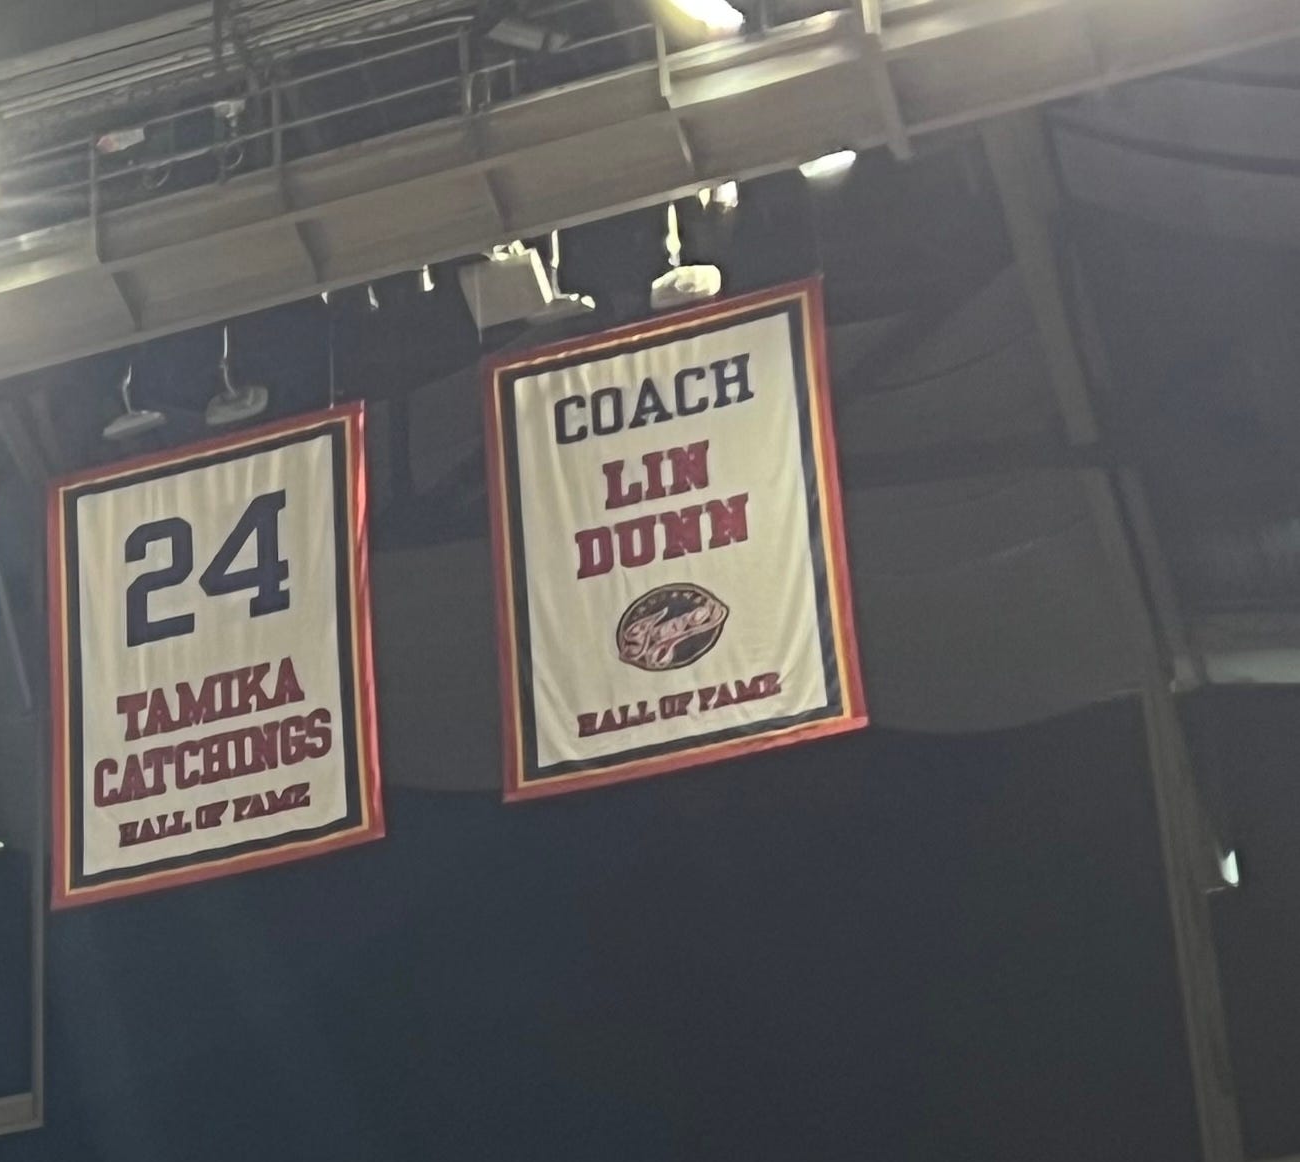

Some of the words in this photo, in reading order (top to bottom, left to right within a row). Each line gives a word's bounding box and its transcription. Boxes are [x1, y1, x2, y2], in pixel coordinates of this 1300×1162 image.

[553, 353, 755, 446] COACH
[604, 438, 711, 512] LIN
[124, 489, 290, 647] 24
[575, 493, 750, 580] DUNN
[116, 656, 305, 741] TAMIKA
[577, 701, 655, 737] HALL
[659, 691, 696, 720] OF
[698, 672, 782, 713] FAME
[94, 707, 332, 807] CATCHINGS
[119, 811, 192, 848] HALL
[195, 800, 229, 829] OF
[232, 782, 310, 822] FAME
